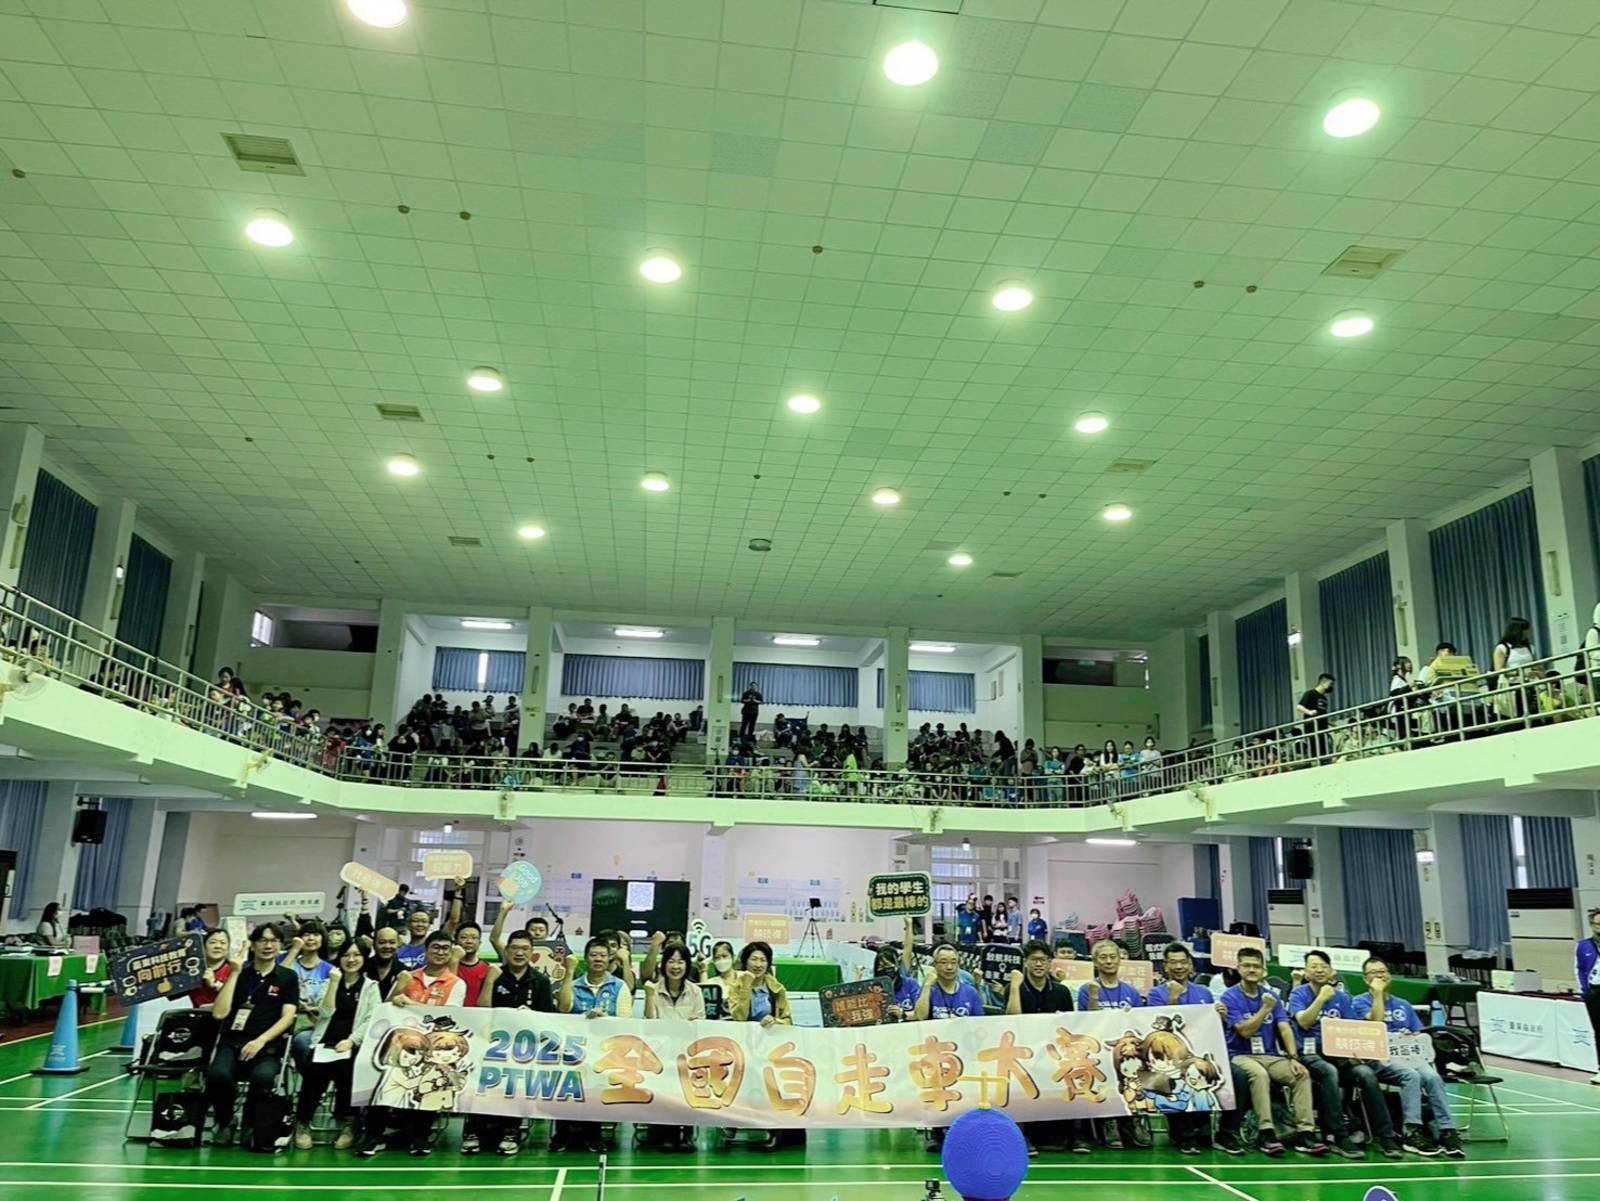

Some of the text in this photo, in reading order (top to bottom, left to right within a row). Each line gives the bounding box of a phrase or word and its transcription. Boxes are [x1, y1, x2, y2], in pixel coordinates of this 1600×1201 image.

[875, 881, 924, 896] 我的學生
[871, 895, 929, 910] 都是最棒的
[689, 933, 711, 958] 5G
[137, 959, 182, 983] 向前行
[483, 1029, 588, 1066] 2025
[593, 1027, 1108, 1116] 全國自走車大賽
[477, 1067, 585, 1102] PTWA
